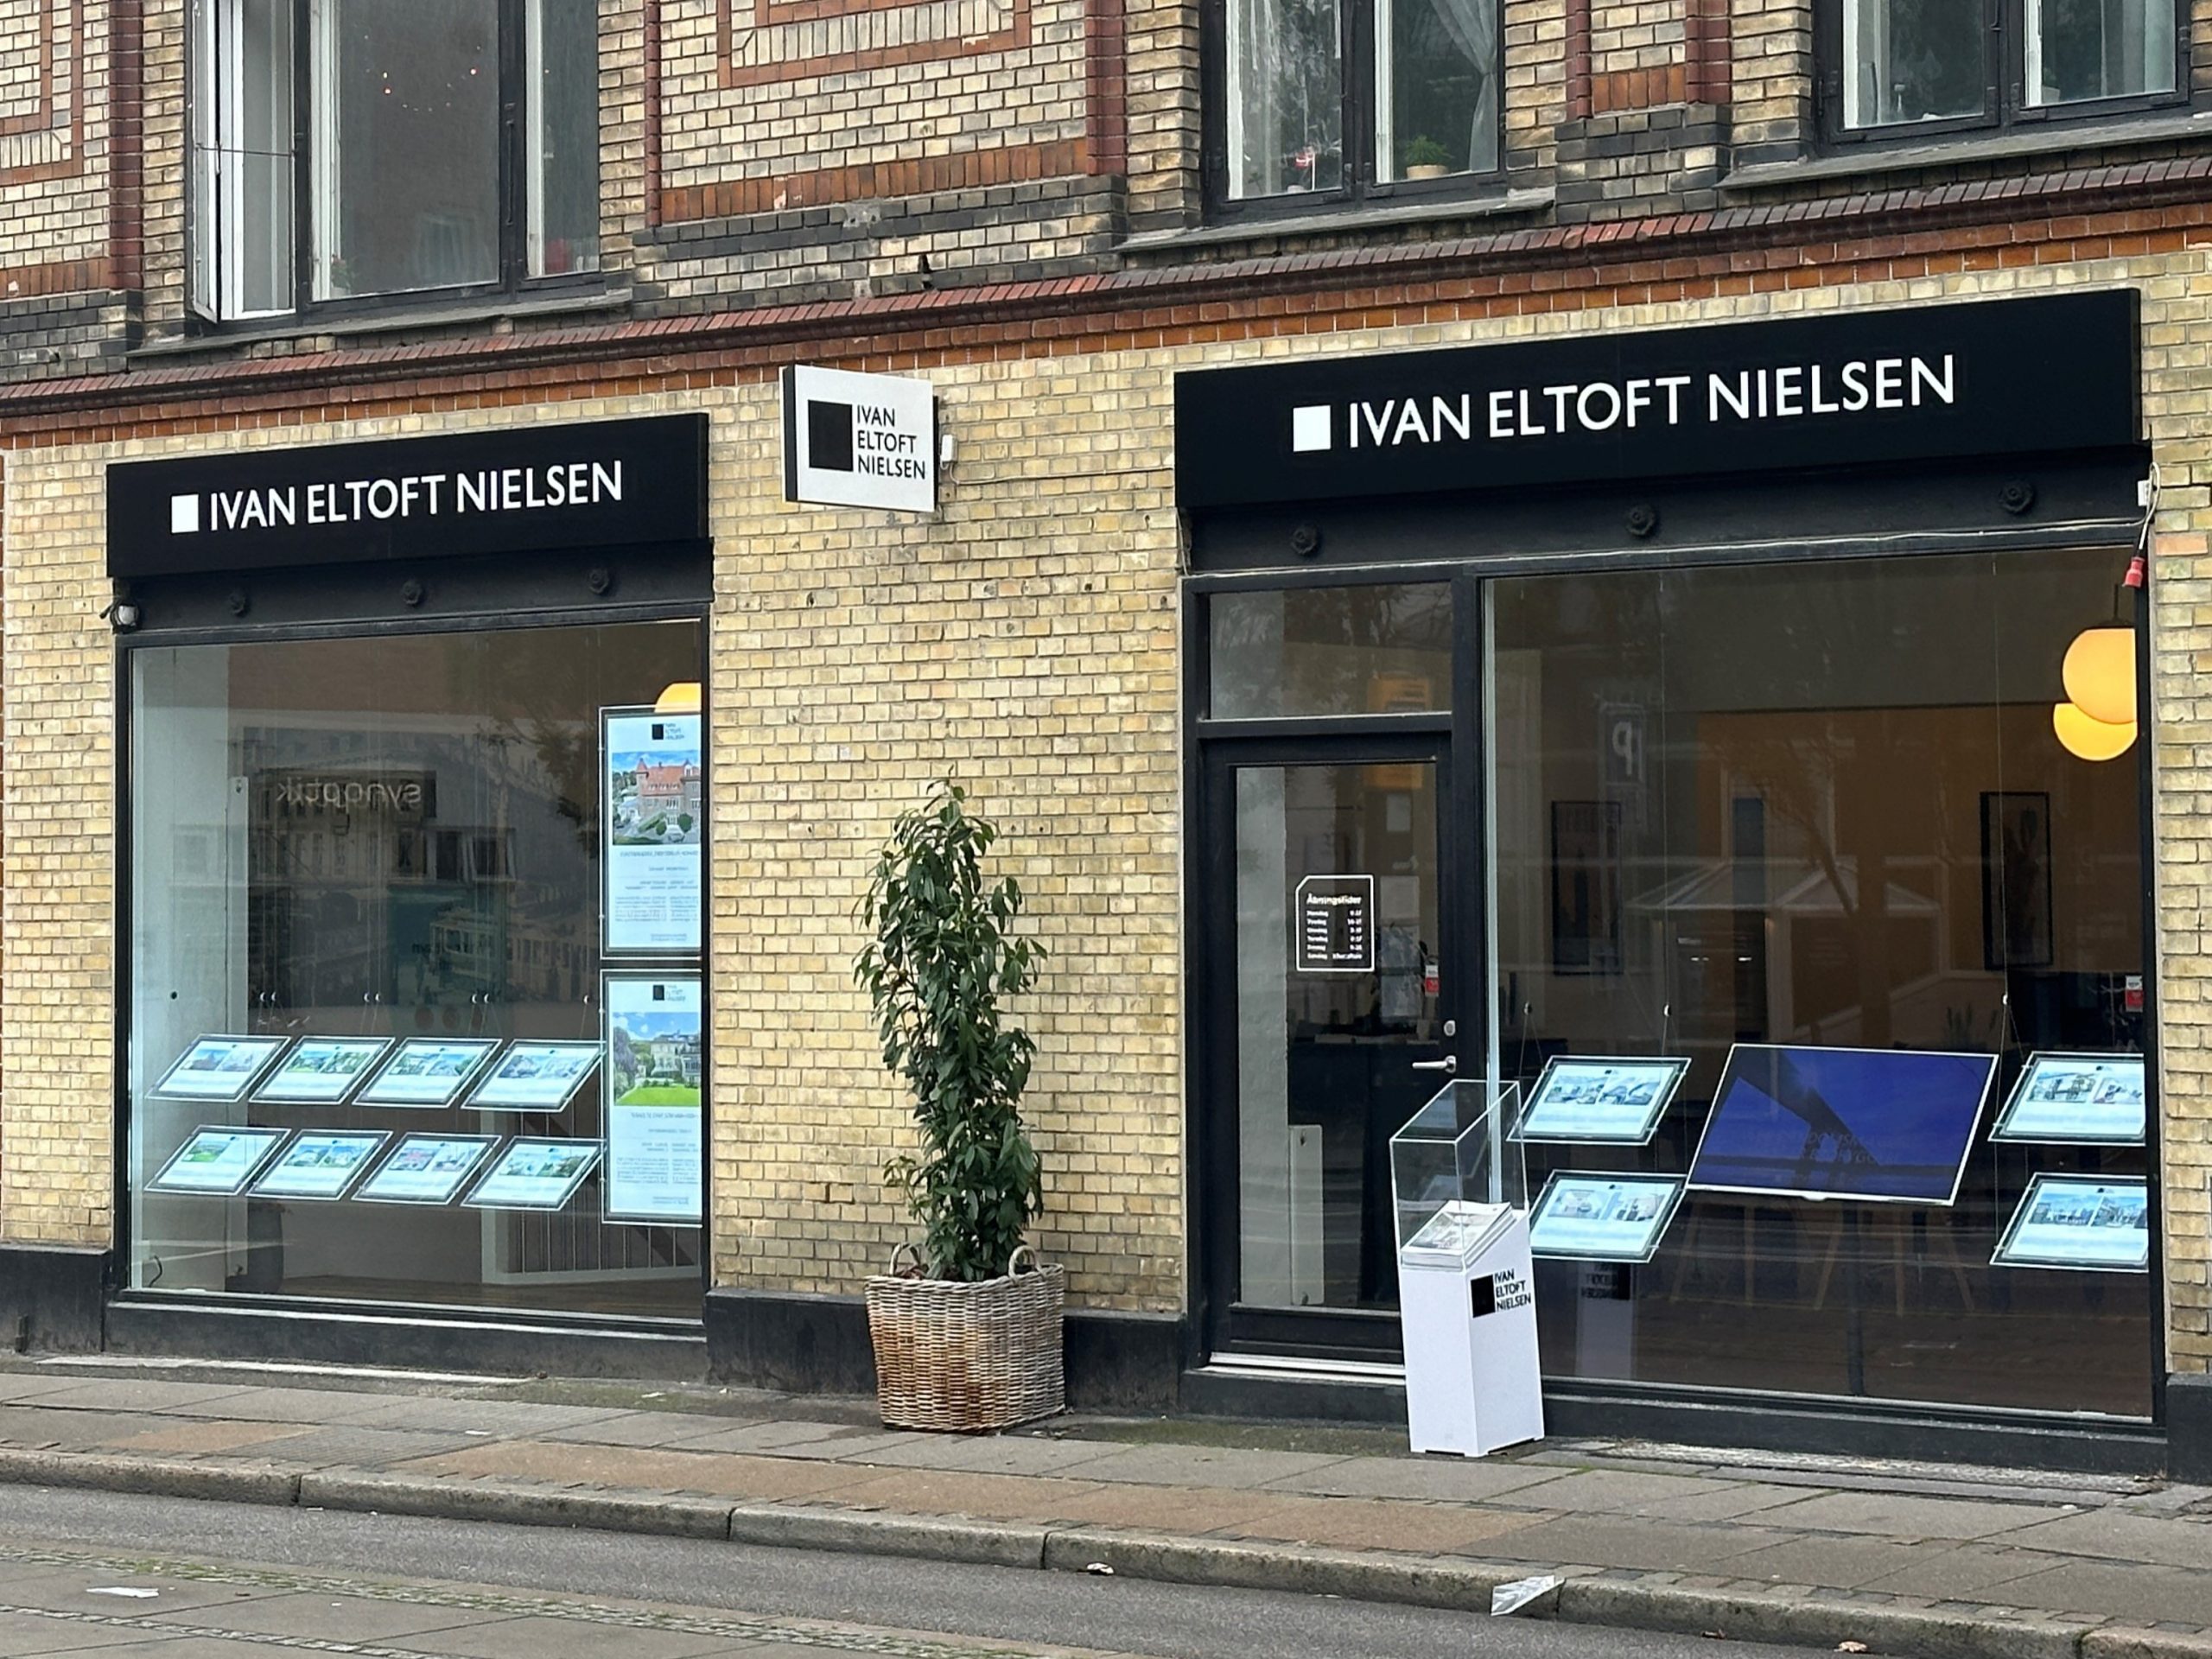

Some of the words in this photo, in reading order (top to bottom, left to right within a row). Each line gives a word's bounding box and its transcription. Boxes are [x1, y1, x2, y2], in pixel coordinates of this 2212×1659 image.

[1350, 393, 1471, 448] IVAN
[1489, 375, 1691, 442] ELTOFT
[1708, 354, 1954, 422] NIELSEN
[857, 404, 895, 427] IVAN
[857, 429, 917, 454] ELTOFT
[858, 454, 925, 480] NIELSEN
[210, 486, 296, 531] IVAN
[307, 474, 447, 524] ELTOFT
[457, 460, 622, 513] NIELSEN
[1494, 1268, 1516, 1284] IVAN
[1496, 1280, 1526, 1299] ELTOFT
[1497, 1293, 1532, 1312] NIELSEN
